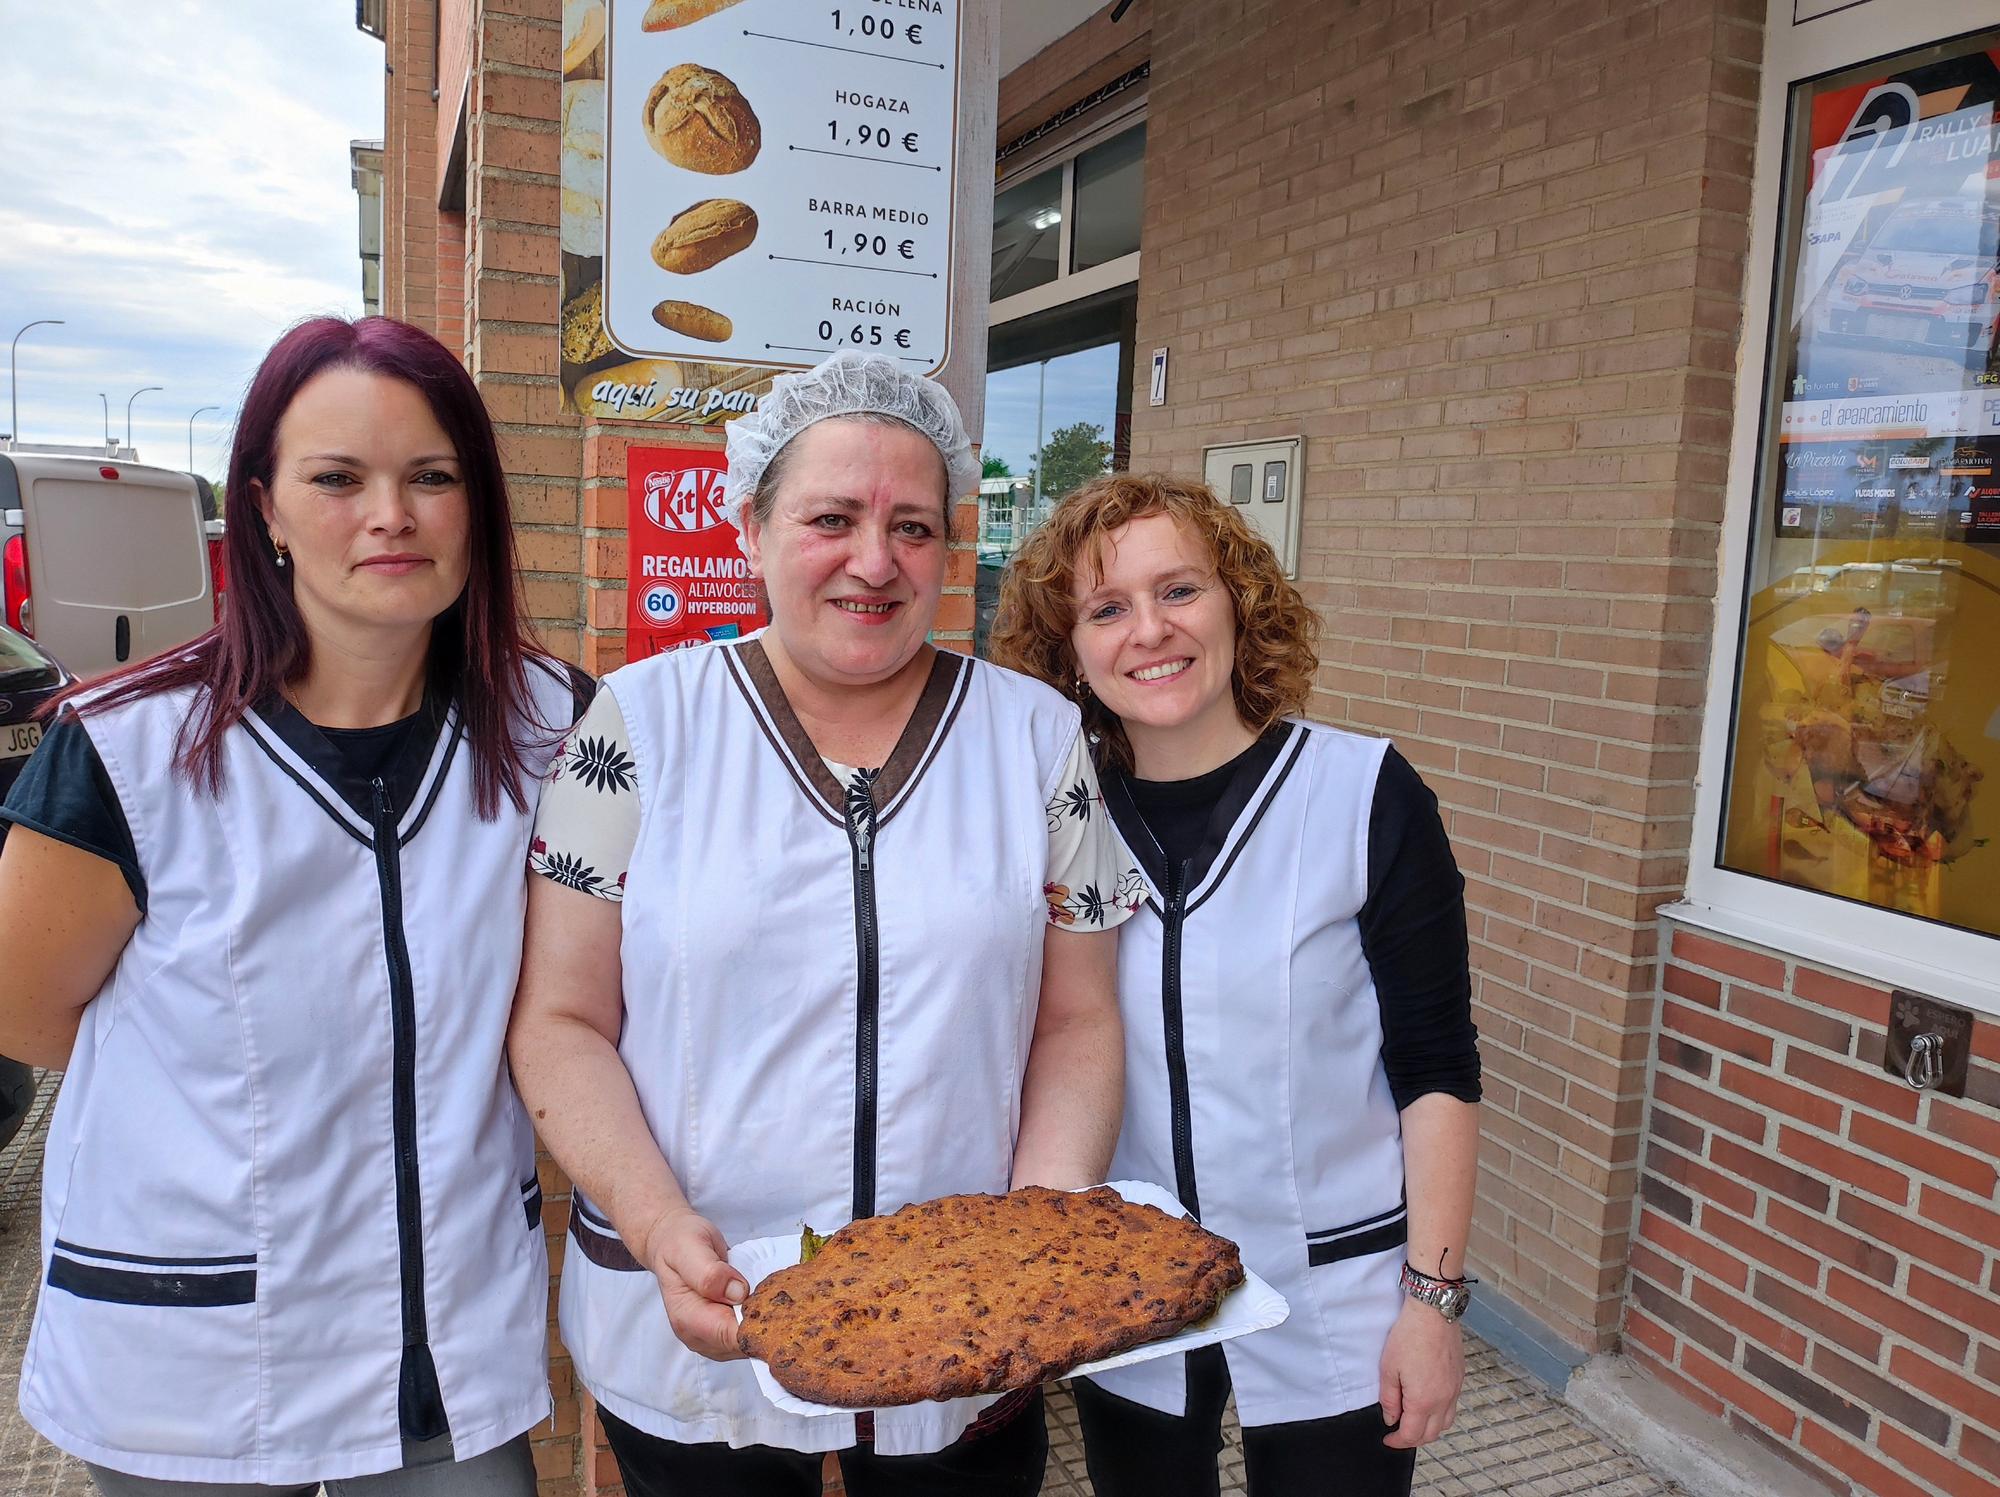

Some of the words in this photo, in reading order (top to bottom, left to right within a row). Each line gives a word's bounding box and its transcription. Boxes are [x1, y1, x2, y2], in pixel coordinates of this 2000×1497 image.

[831, 9, 895, 40] 1,00
[904, 23, 923, 45] €
[835, 89, 910, 115] HOGAZA
[827, 119, 891, 149] 1,90
[901, 132, 919, 153] €
[1919, 114, 1983, 143] RALLY
[809, 198, 867, 219] BARRA
[872, 206, 929, 226] MEDIO
[823, 229, 887, 256] 1,90
[897, 239, 915, 260] €
[832, 297, 900, 317] RACIÓN
[818, 320, 882, 346] 0,65
[893, 328, 911, 349] €
[1154, 356, 1164, 398] 7
[592, 379, 657, 413] aquí,
[667, 387, 701, 410] su
[701, 388, 757, 417] pan
[1821, 404, 1833, 426] el
[1785, 452, 1801, 469] La
[658, 469, 727, 530] KitKa
[642, 555, 755, 579] REGALAMO
[647, 593, 676, 612] 60
[687, 601, 757, 615] HYPERBOOM
[8, 726, 40, 752] JGG
